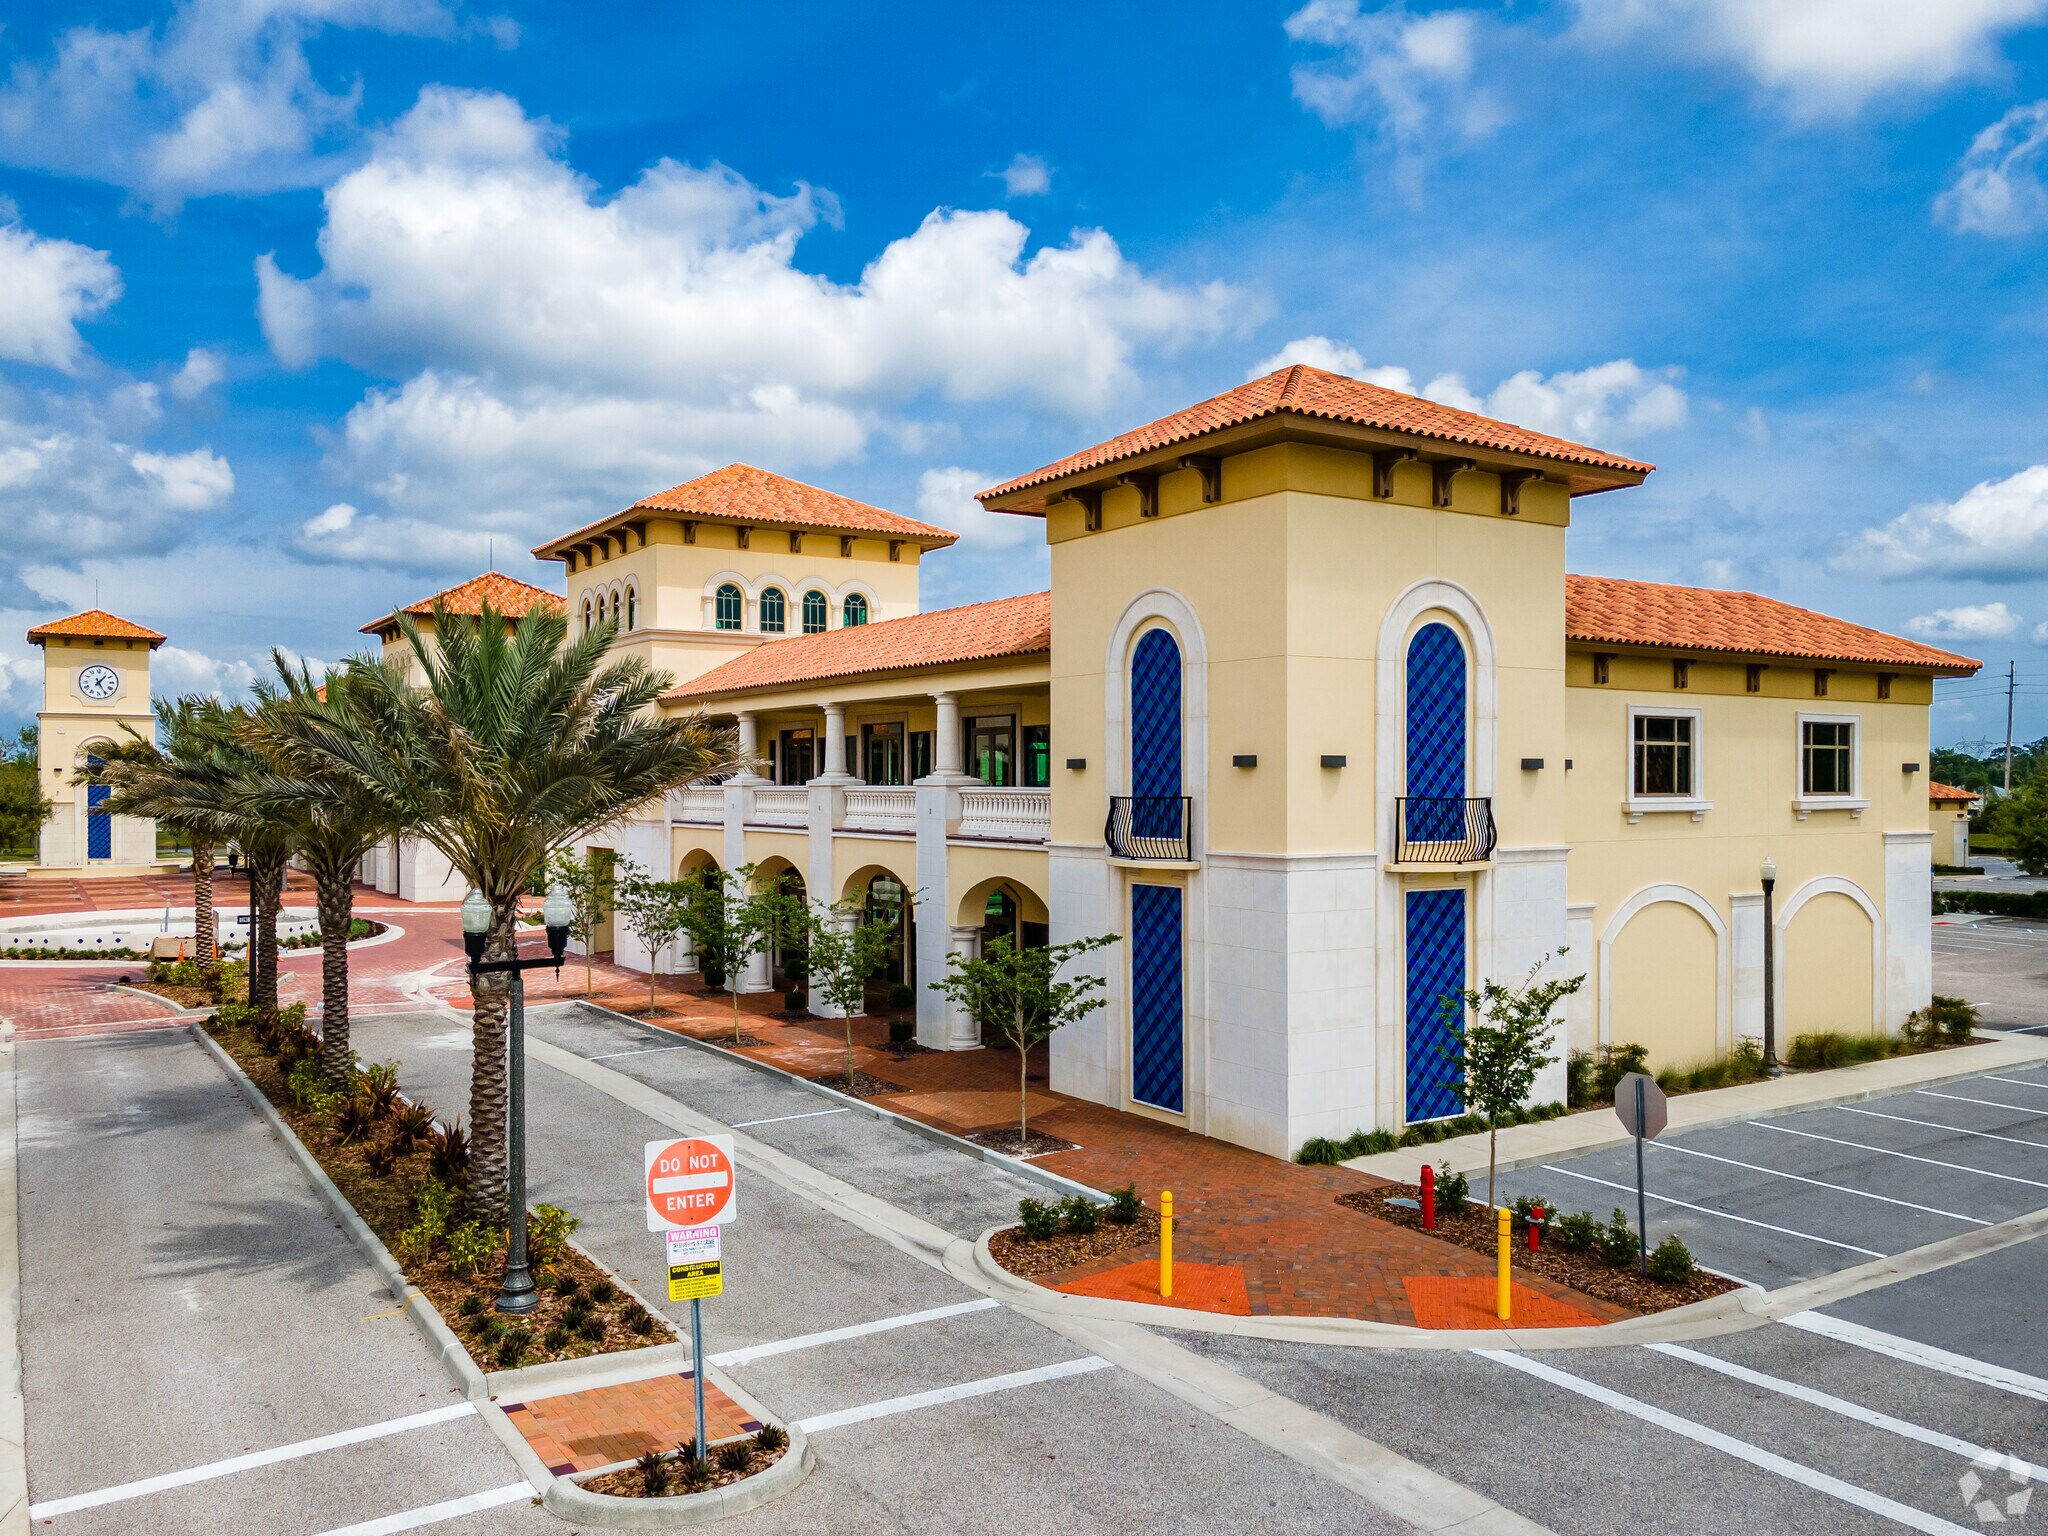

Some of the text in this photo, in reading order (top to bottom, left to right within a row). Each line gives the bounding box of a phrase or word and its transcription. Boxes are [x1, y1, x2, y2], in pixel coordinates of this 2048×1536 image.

[660, 1154, 718, 1173] DO NOT
[666, 1193, 715, 1211] ENTER
[670, 1227, 717, 1241] WARNING
[687, 1270, 704, 1278] AREA
